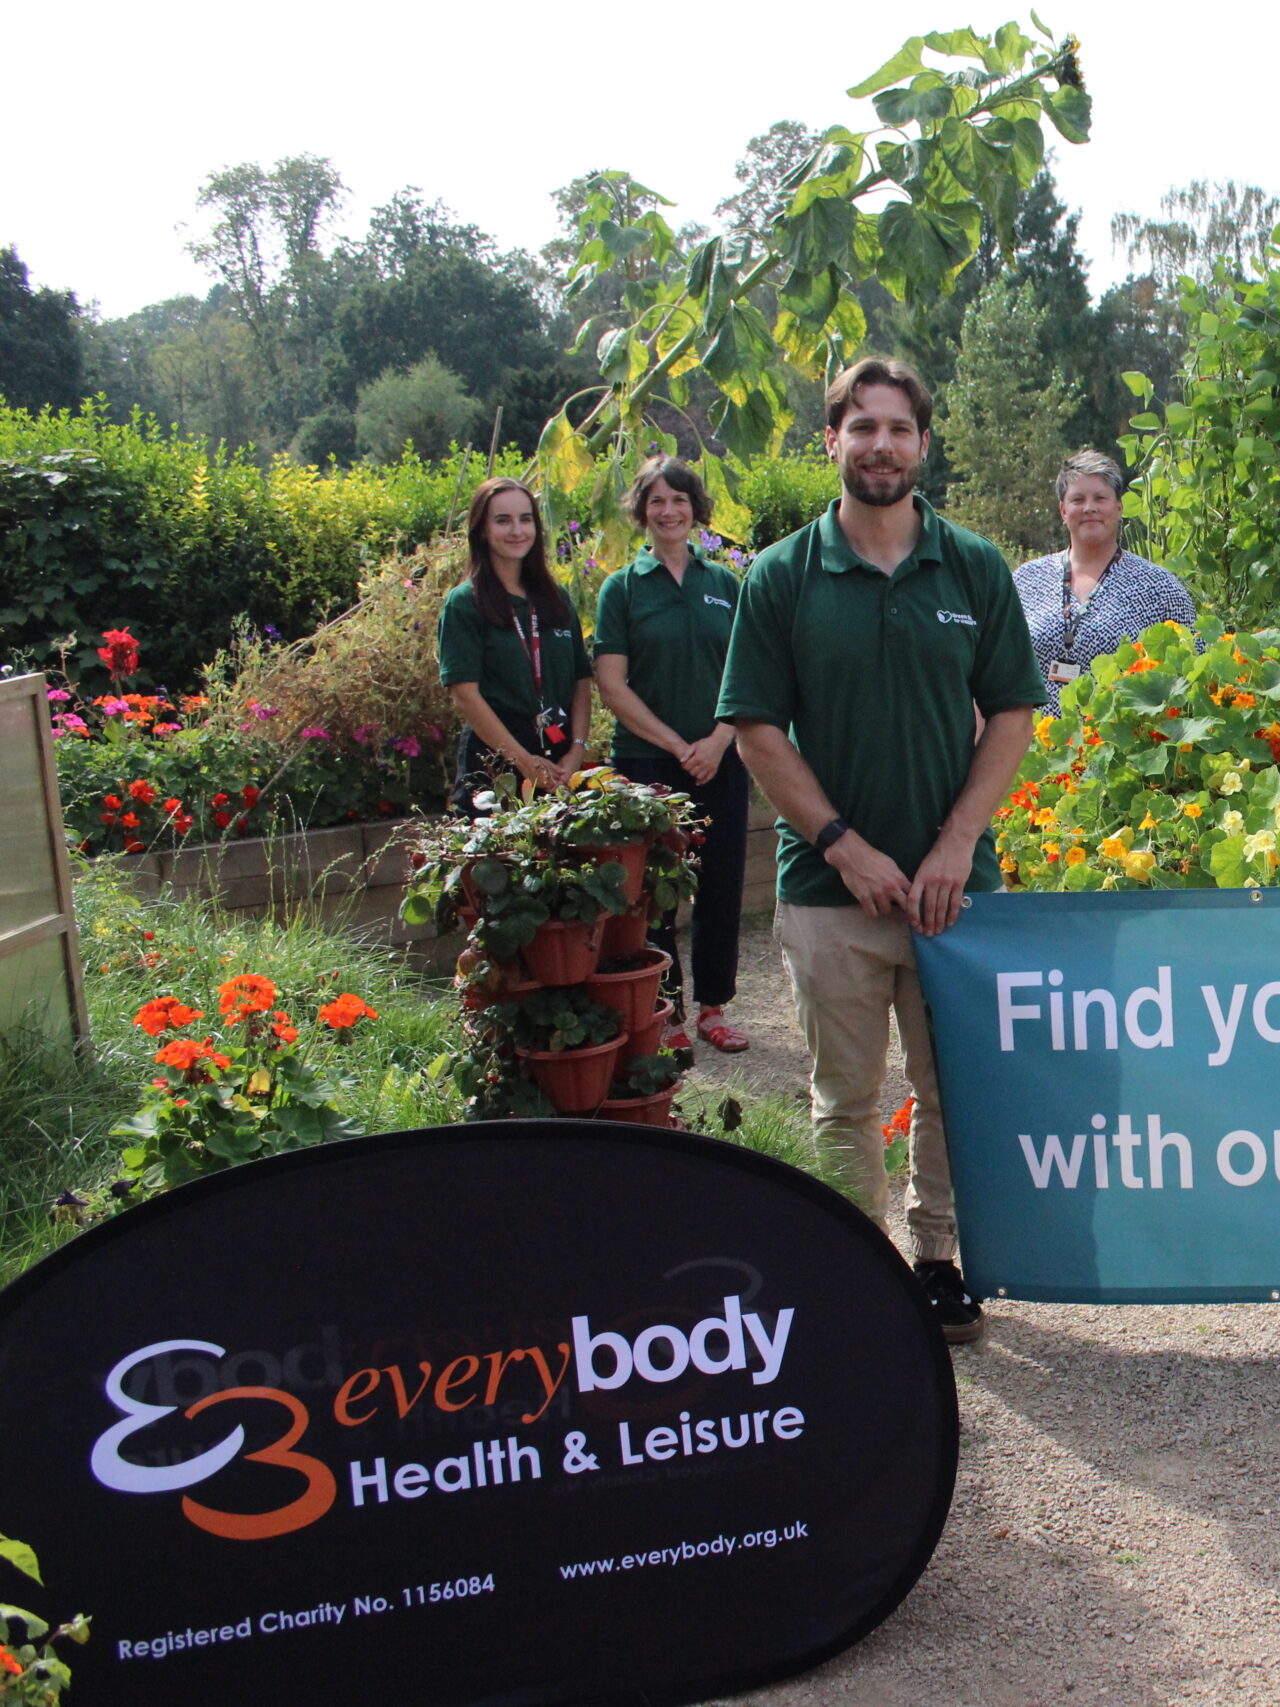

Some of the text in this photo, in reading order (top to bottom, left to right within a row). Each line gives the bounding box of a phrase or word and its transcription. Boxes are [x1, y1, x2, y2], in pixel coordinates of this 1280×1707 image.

[996, 965, 1174, 1051] Find
[1018, 1113, 1194, 1189] with
[333, 1294, 796, 1426] everybody
[349, 1436, 542, 1507] Health
[562, 1430, 601, 1474] &
[618, 1406, 805, 1466] Leisure
[559, 1520, 809, 1580] www.everybody.org.uk
[118, 1573, 495, 1660] Registered Charity No. 1156084
